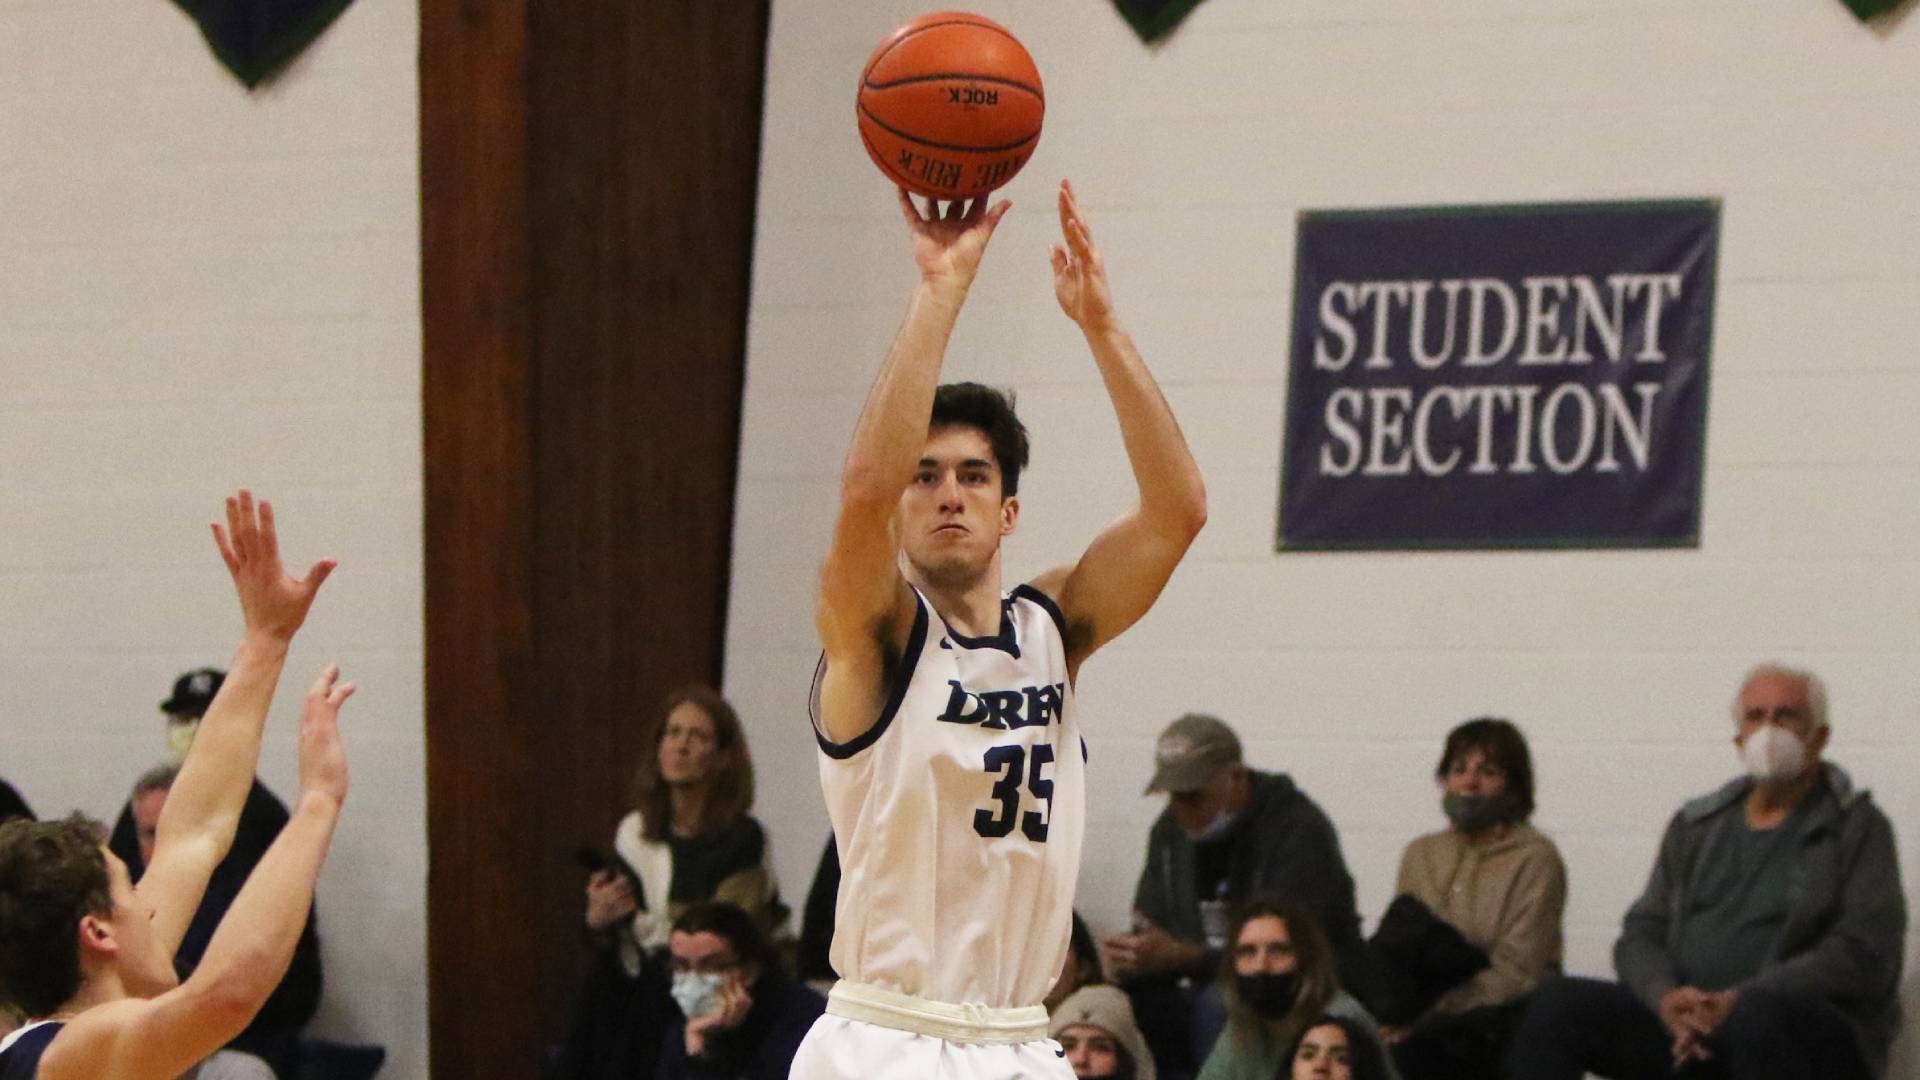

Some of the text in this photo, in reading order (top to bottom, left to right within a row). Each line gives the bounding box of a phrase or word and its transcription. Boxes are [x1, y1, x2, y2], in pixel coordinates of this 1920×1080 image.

[948, 87, 998, 106] ROCK
[898, 149, 964, 189] ROCK
[1314, 273, 1682, 371] STUDENT
[1320, 382, 1661, 477] SECTION
[973, 743, 1054, 843] 35
